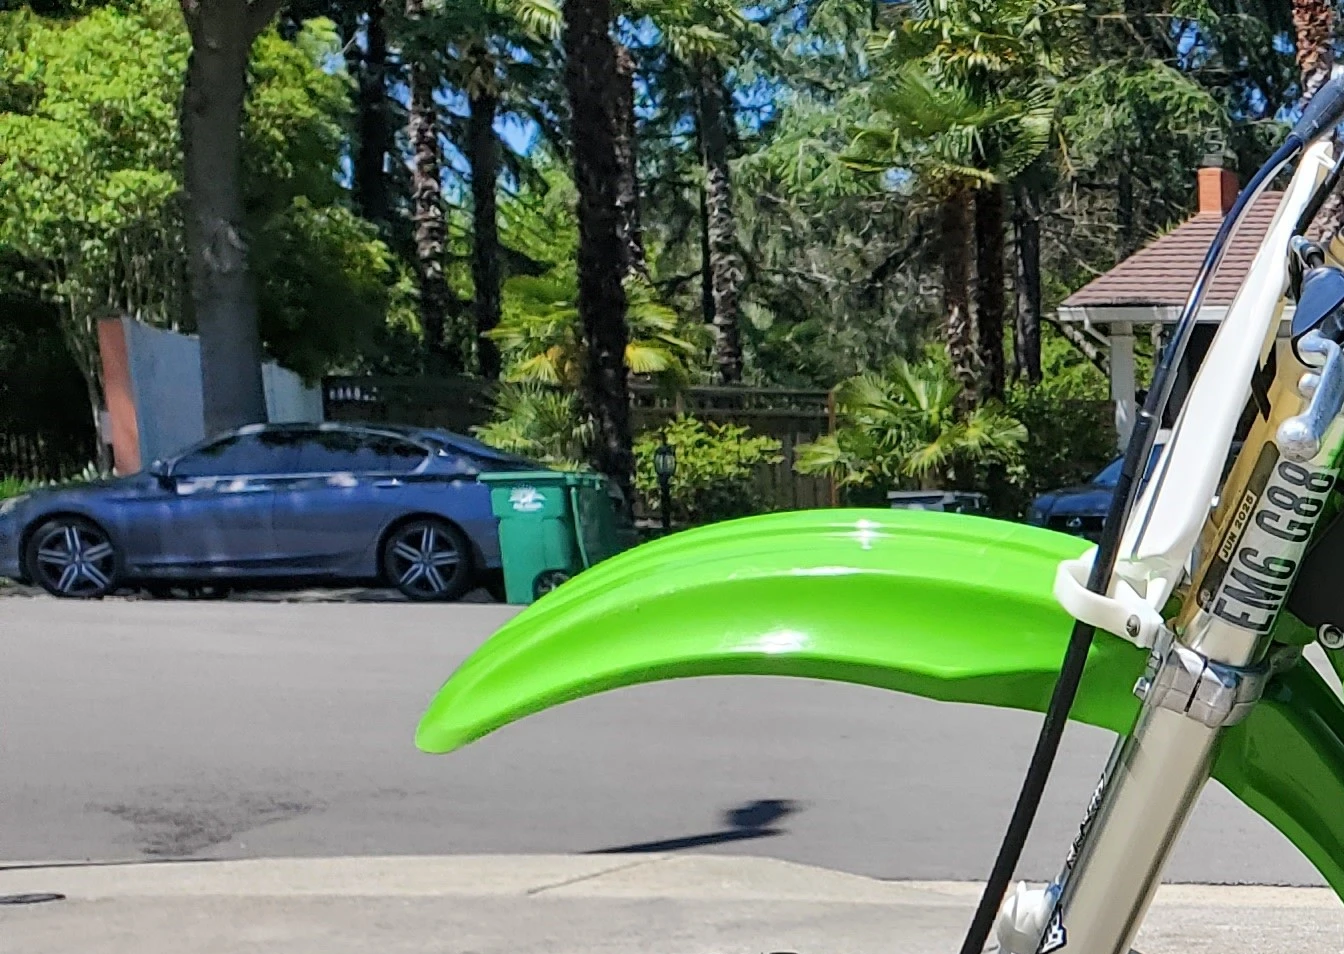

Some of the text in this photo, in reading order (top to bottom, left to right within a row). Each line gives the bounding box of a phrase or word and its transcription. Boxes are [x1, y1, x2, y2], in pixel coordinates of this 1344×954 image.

[1212, 460, 1335, 632] EM6 G88
[1220, 533, 1238, 558] JUN
